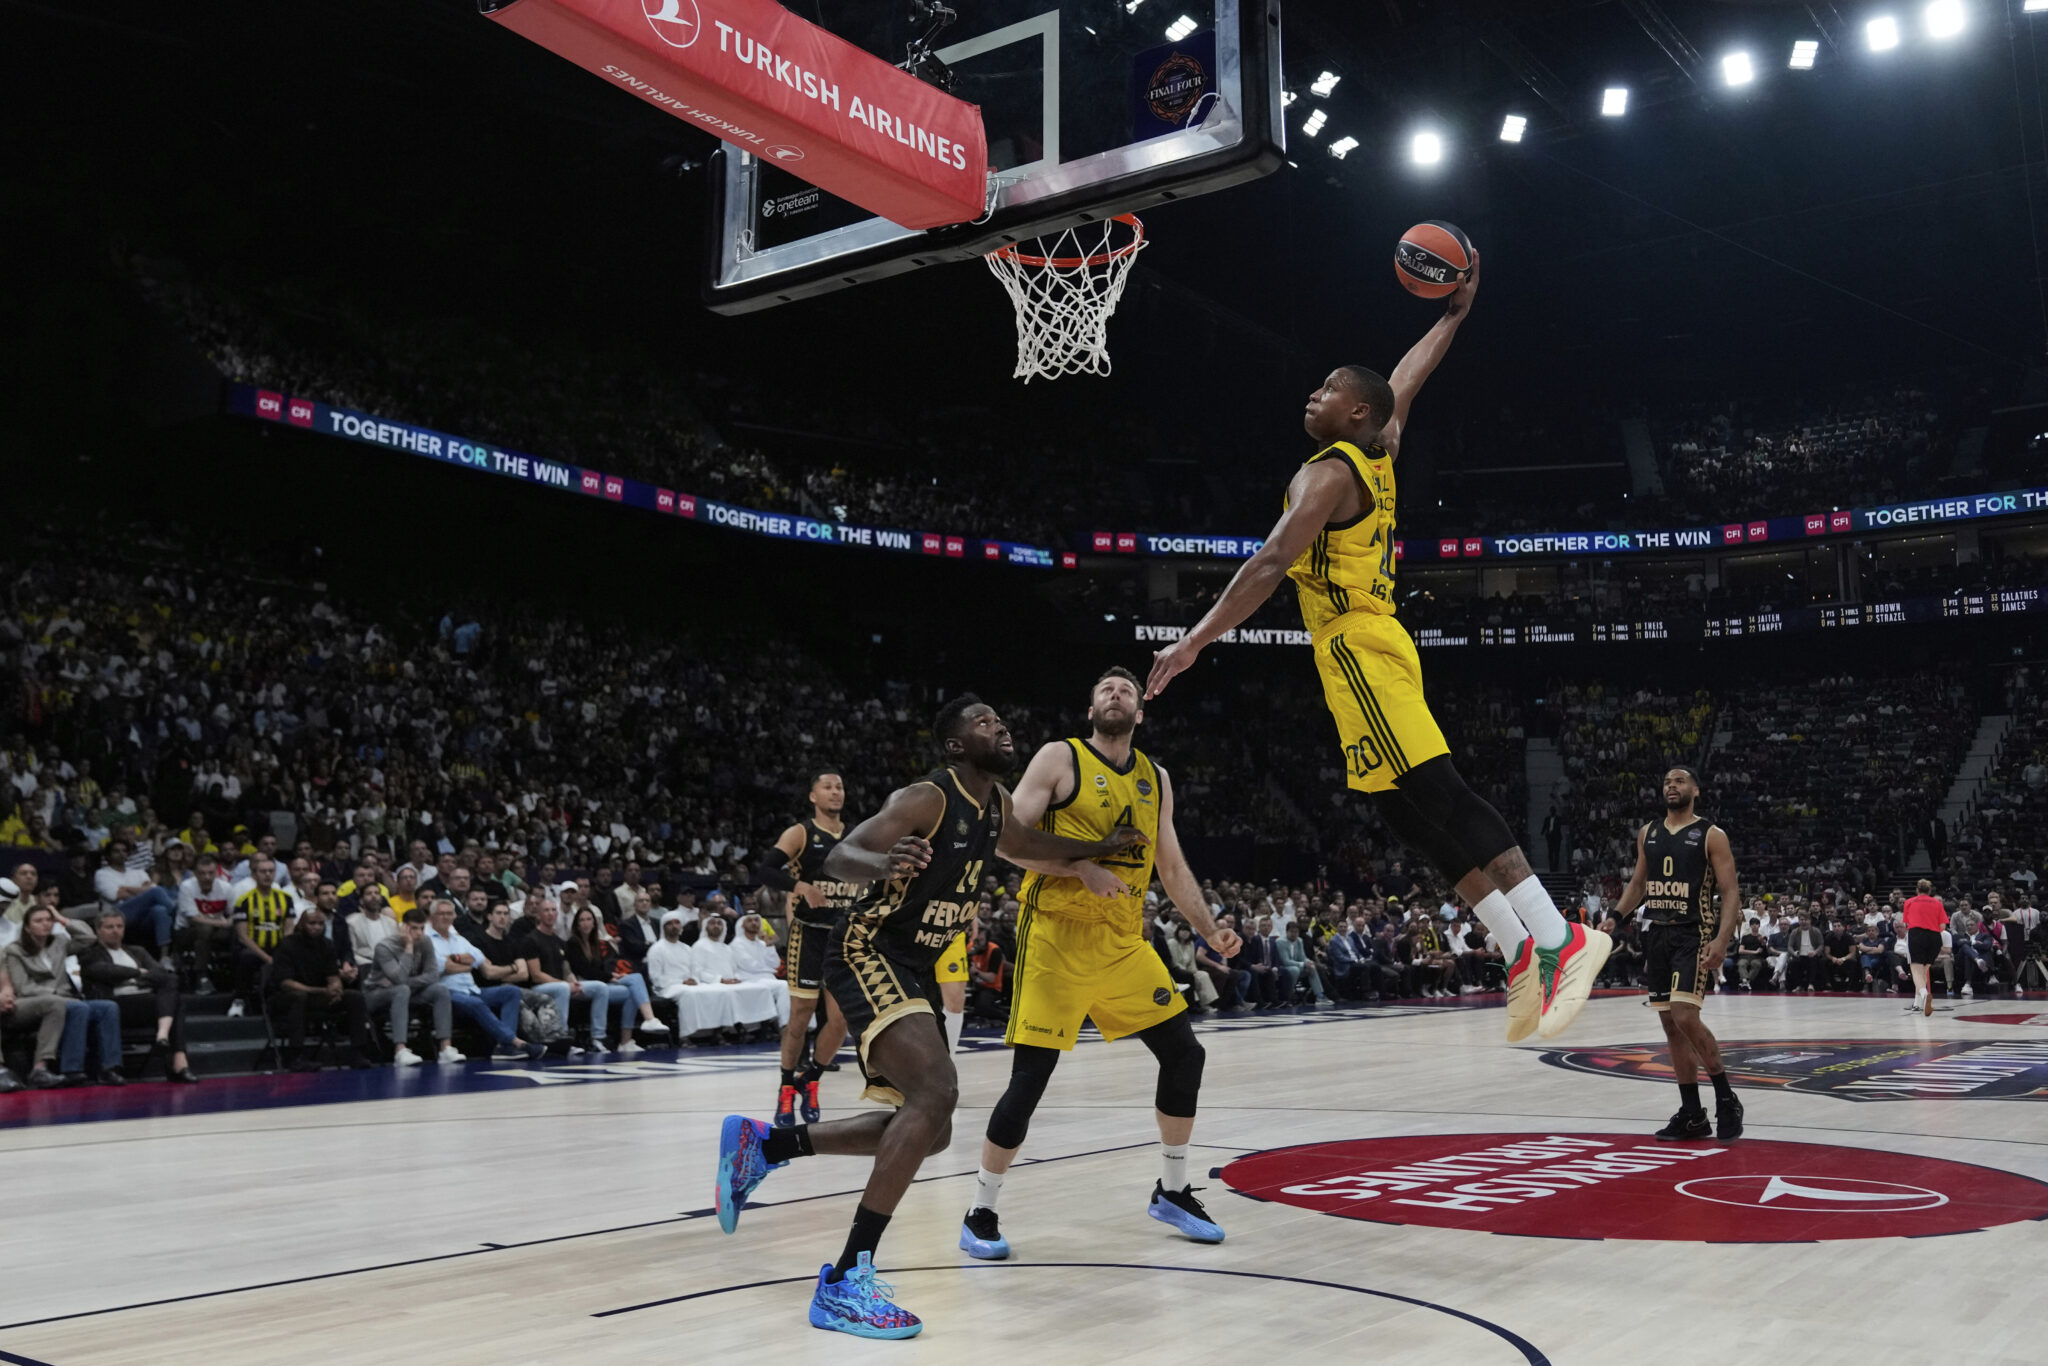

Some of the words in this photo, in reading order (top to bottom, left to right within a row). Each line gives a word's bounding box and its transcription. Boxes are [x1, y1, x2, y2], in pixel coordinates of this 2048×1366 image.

[601, 64, 690, 110] AIRLINES
[1150, 84, 1174, 100] FINAL
[1177, 76, 1202, 92] FOUR
[715, 20, 840, 112] TURKISH
[849, 96, 967, 170] AIRLINES
[687, 109, 765, 145] TURKISH
[777, 193, 819, 212] oneteam
[259, 398, 280, 412] CFI
[291, 406, 311, 420] CFI
[330, 411, 442, 456] TOGETHER
[447, 440, 488, 467] FOR
[493, 451, 529, 477] THE
[533, 461, 570, 487] WIN
[583, 475, 599, 490] CFI
[606, 481, 622, 496] CFI
[659, 493, 673, 507] CFI
[680, 499, 694, 512] CFI
[1865, 502, 1970, 527] TOGETHER
[1976, 494, 2017, 515] FOR
[2022, 490, 2048, 509] TH
[706, 503, 791, 536] TOGETHER
[796, 521, 833, 541] FOR
[837, 526, 872, 545] THE
[875, 530, 911, 549] WIN
[1807, 519, 1823, 530] CFI
[1833, 517, 1849, 527] CFI
[1726, 529, 1741, 539] CFI
[1750, 526, 1765, 537] CFI
[923, 538, 940, 549] CFI
[946, 541, 962, 552] CFI
[1095, 536, 1111, 548] CFI
[1118, 537, 1134, 548] CFI
[1148, 537, 1238, 554] TOGETHER
[1242, 541, 1266, 556] FO
[1441, 543, 1457, 553] CFI
[1465, 542, 1480, 552] CFI
[1495, 537, 1589, 554] TOGETHER
[1594, 535, 1630, 550] FOR
[1635, 532, 1670, 548] THE
[1675, 530, 1711, 546] WIN
[2000, 590, 2038, 602] CALATHES
[1875, 602, 1900, 614] BROWN
[2002, 601, 2026, 612] JAMES
[1758, 614, 1780, 624] JAITEH
[1876, 612, 1906, 623] STRAZEL
[1530, 625, 1547, 634] LOYD
[1644, 621, 1663, 630] THEIS
[1758, 622, 1782, 632] TARPEY
[1135, 625, 1187, 641] EVERY
[1240, 628, 1313, 646] MATTERS
[1644, 630, 1668, 639] DIALLO
[1346, 735, 1383, 779] 20
[1662, 856, 1674, 877] 0
[955, 859, 984, 894] 14
[1672, 971, 1680, 992] 0
[1280, 1135, 1615, 1201] AIRLINES
[1389, 1145, 1729, 1212] TURKISH
